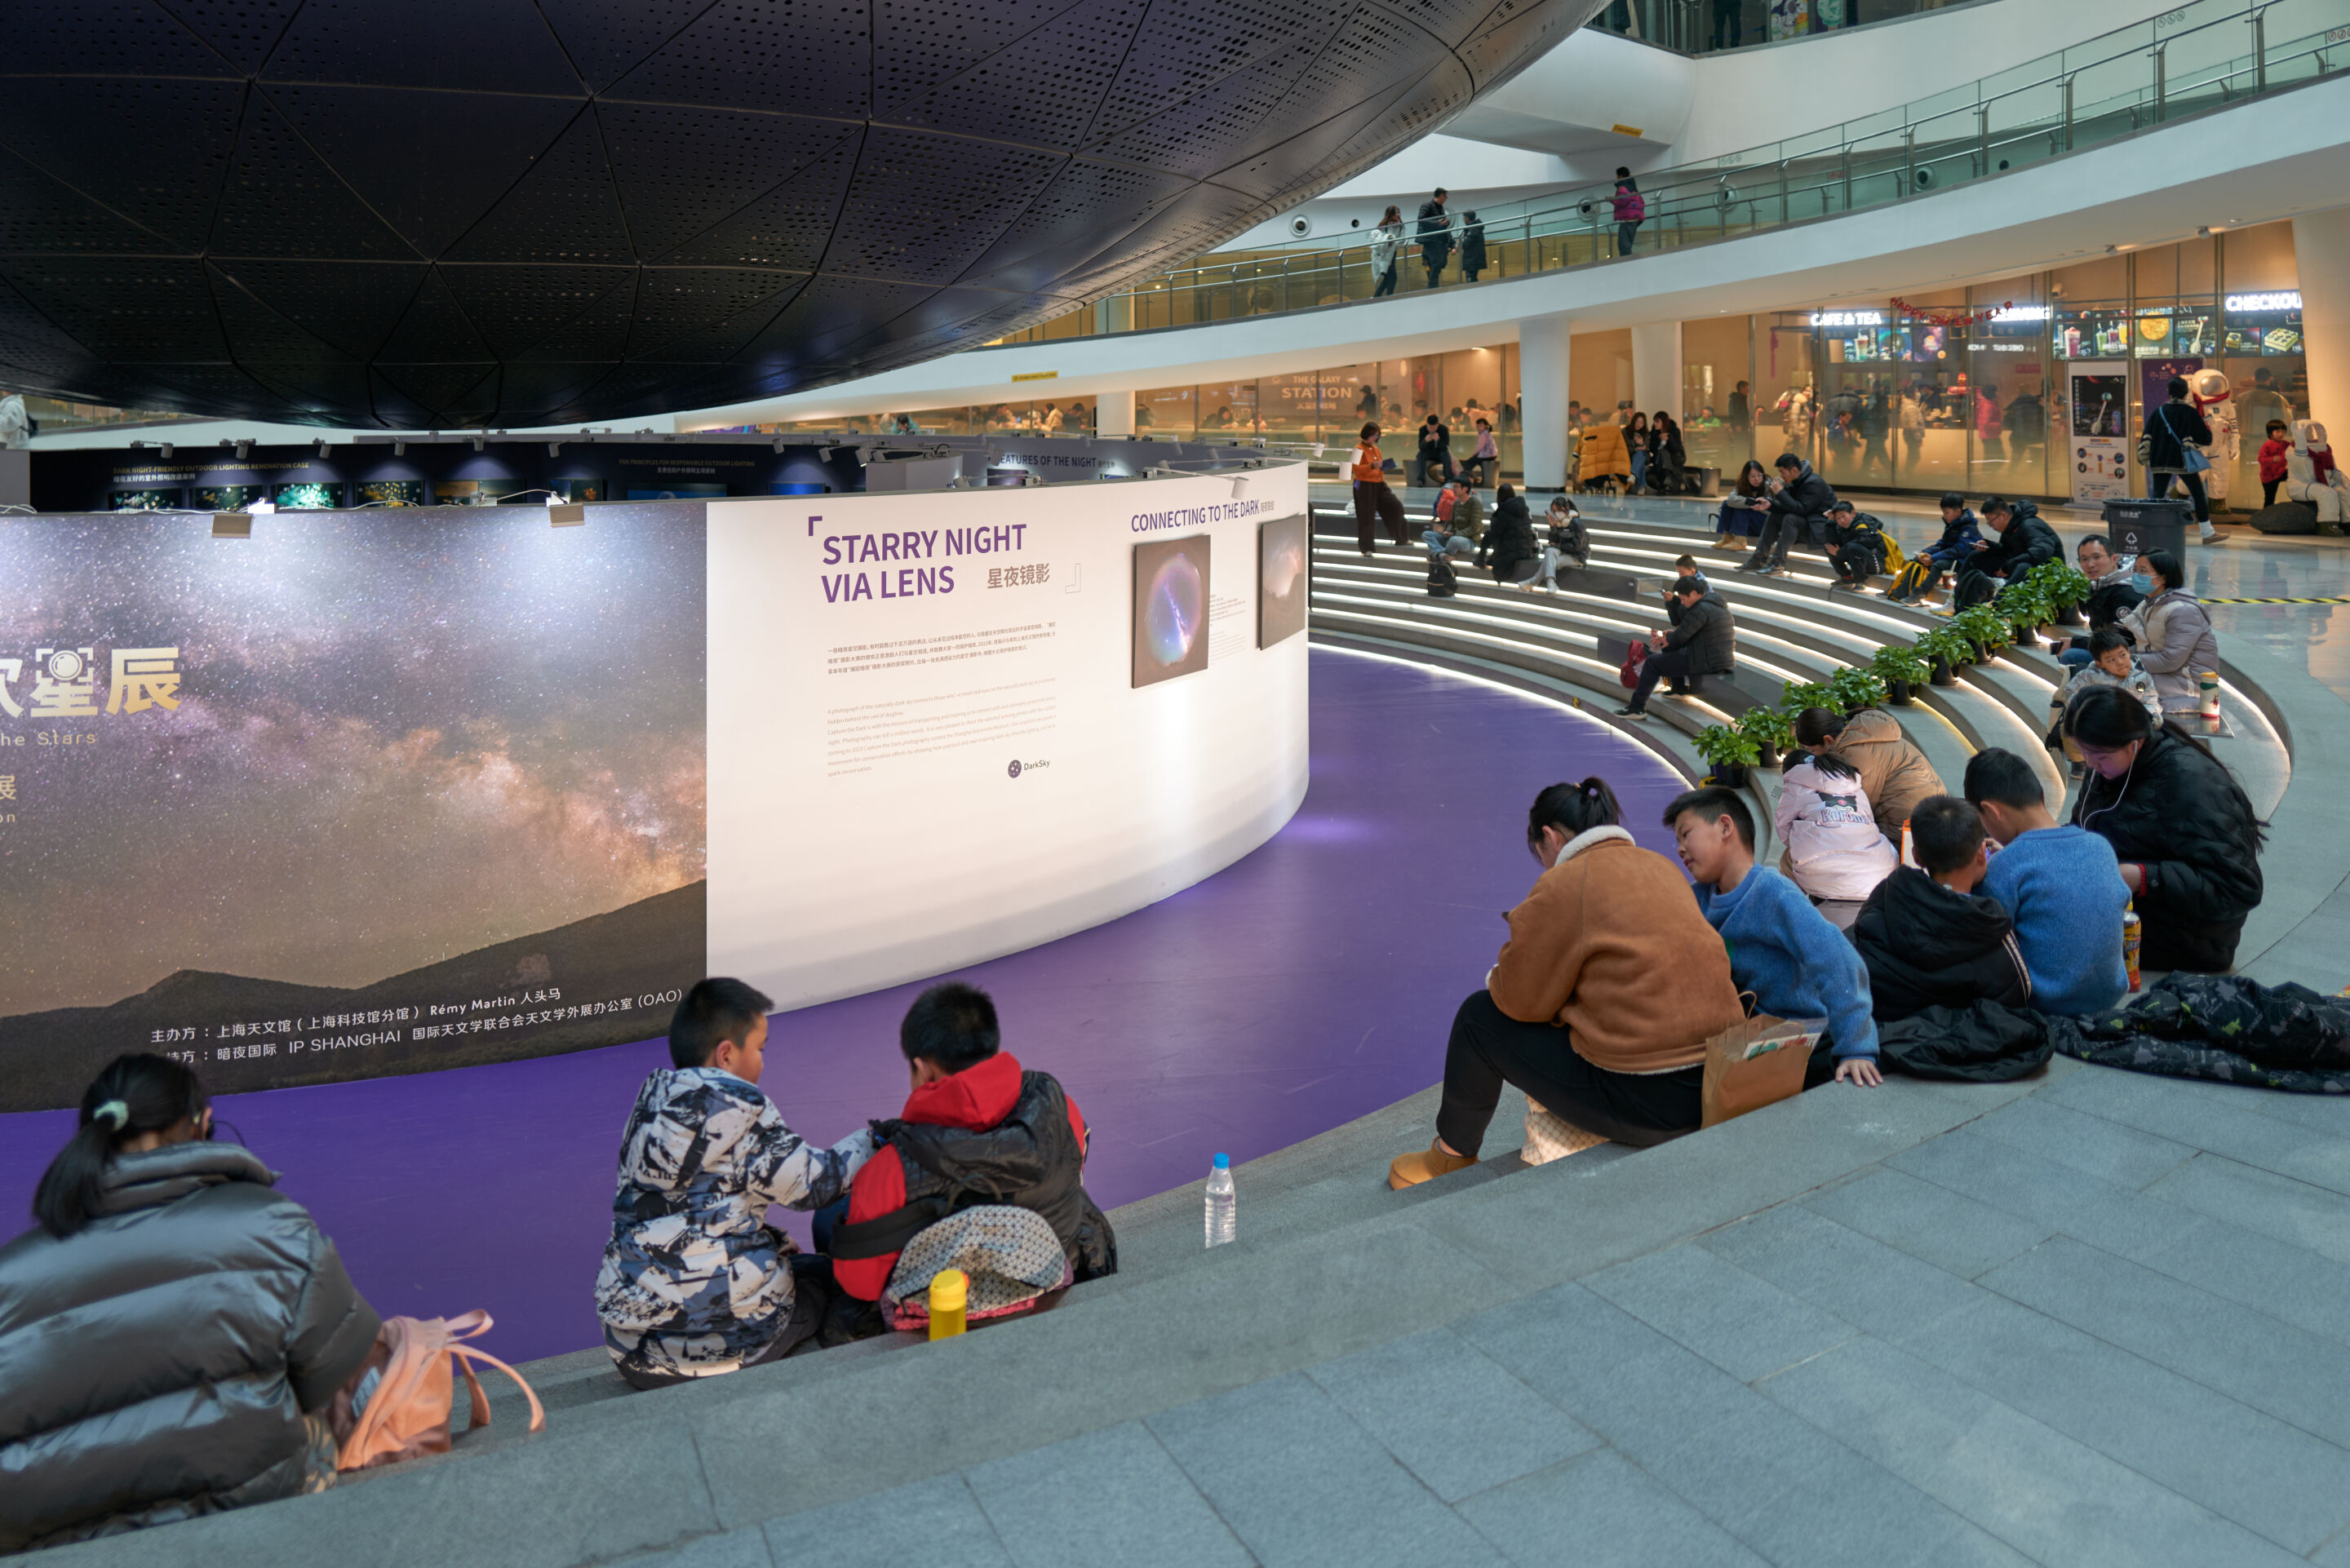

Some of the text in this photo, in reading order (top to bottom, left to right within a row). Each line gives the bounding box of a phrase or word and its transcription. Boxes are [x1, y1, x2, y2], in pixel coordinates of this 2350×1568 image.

[1811, 313, 1843, 326] CAFE
[1855, 312, 1882, 325] TEA
[1890, 297, 1925, 320] HAPPY
[1282, 388, 1351, 398] STATION
[131, 466, 184, 474] NIGHT-FRIENDLY
[1000, 454, 1097, 467] EATURES OF THE NIGHT
[1132, 507, 1206, 532] CONNECTING
[1208, 505, 1221, 522] TO
[1223, 503, 1239, 520] THE
[1240, 498, 1260, 517] DARK
[822, 524, 1026, 565] STARRY NIGHT
[822, 565, 955, 604] VIA LENS
[987, 563, 1050, 590] 星夜镜影
[38, 732, 96, 746] Stars
[1023, 759, 1050, 772] DarkSky
[0, 775, 16, 800] 展
[430, 1003, 466, 1017] Rémy
[472, 995, 516, 1010] Martin
[521, 988, 561, 1005] 人头马
[217, 1043, 277, 1061] 暗夜国际
[289, 1040, 304, 1054] IP
[311, 1030, 401, 1052] SHANGHAI
[412, 998, 633, 1041] 国际天文学联合会天文学外展办公室
[638, 988, 682, 1008] (OAO)
